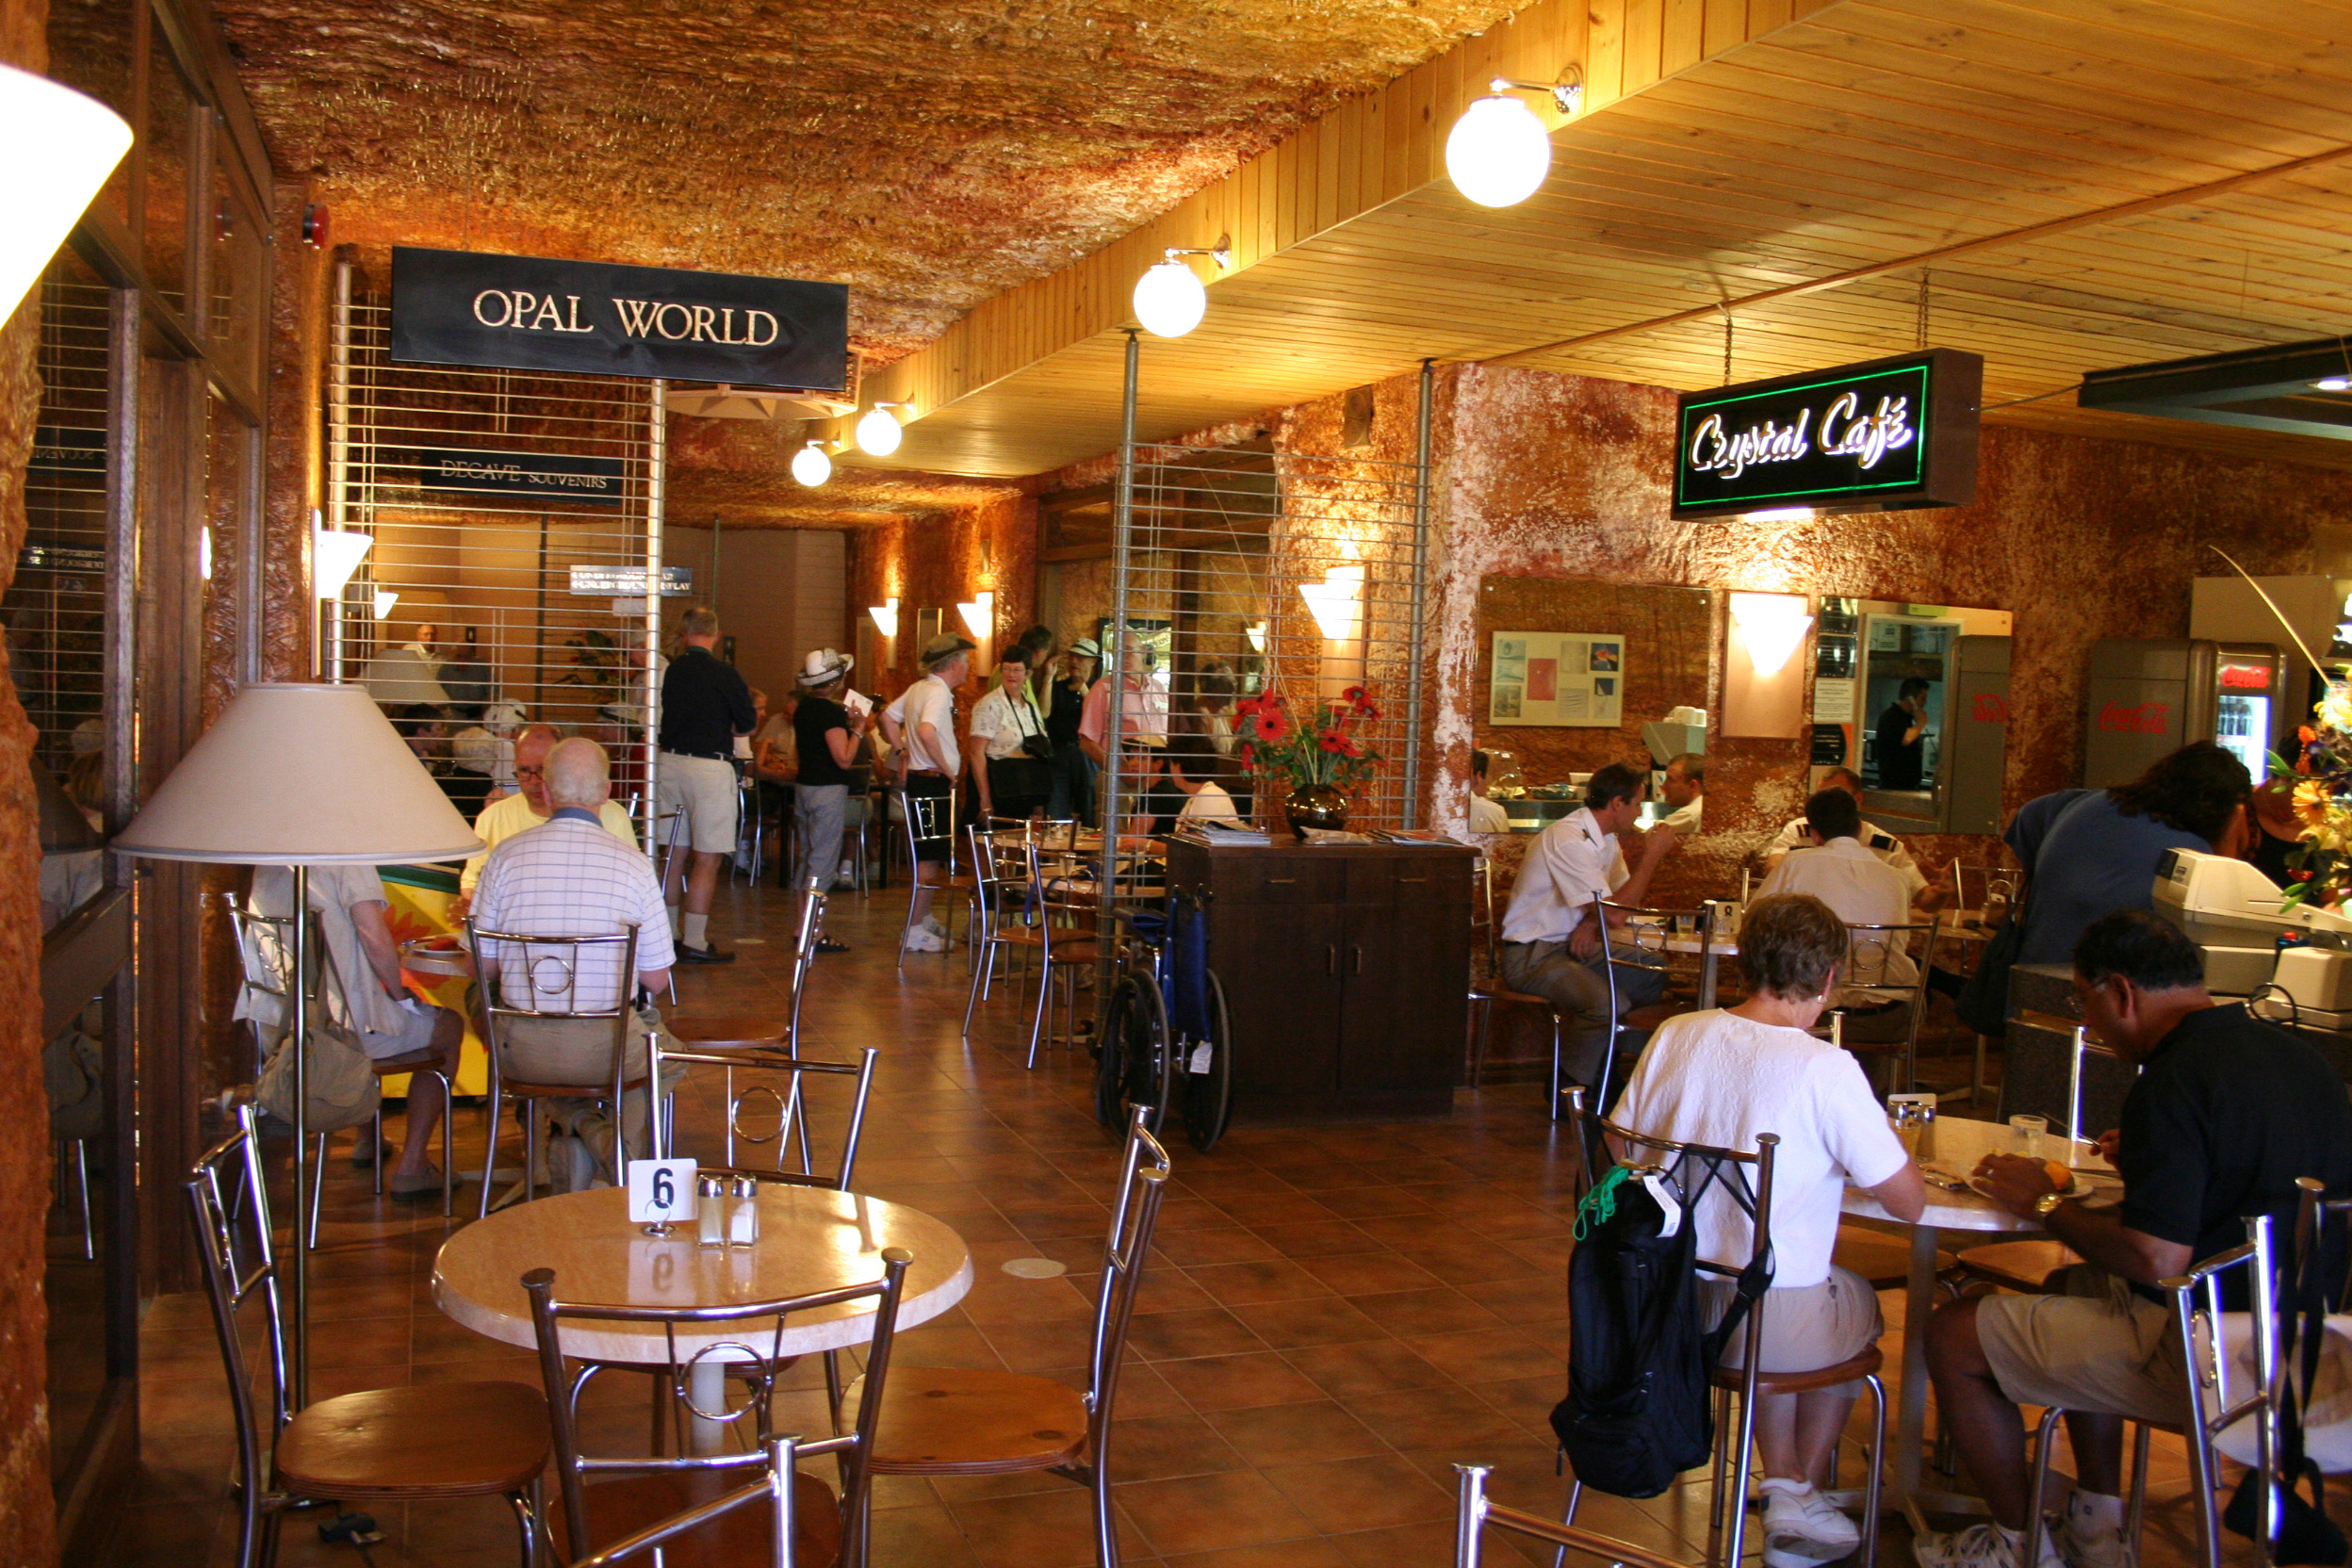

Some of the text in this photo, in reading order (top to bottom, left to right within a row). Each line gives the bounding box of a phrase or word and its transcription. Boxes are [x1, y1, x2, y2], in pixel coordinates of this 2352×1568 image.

[473, 289, 779, 347] OPAL WORLD
[1689, 392, 1915, 480] Crystal Café
[440, 459, 608, 489] DECAVE SOUVENIRS
[2099, 700, 2171, 735] Coca-Cola
[653, 1168, 675, 1209] 6
